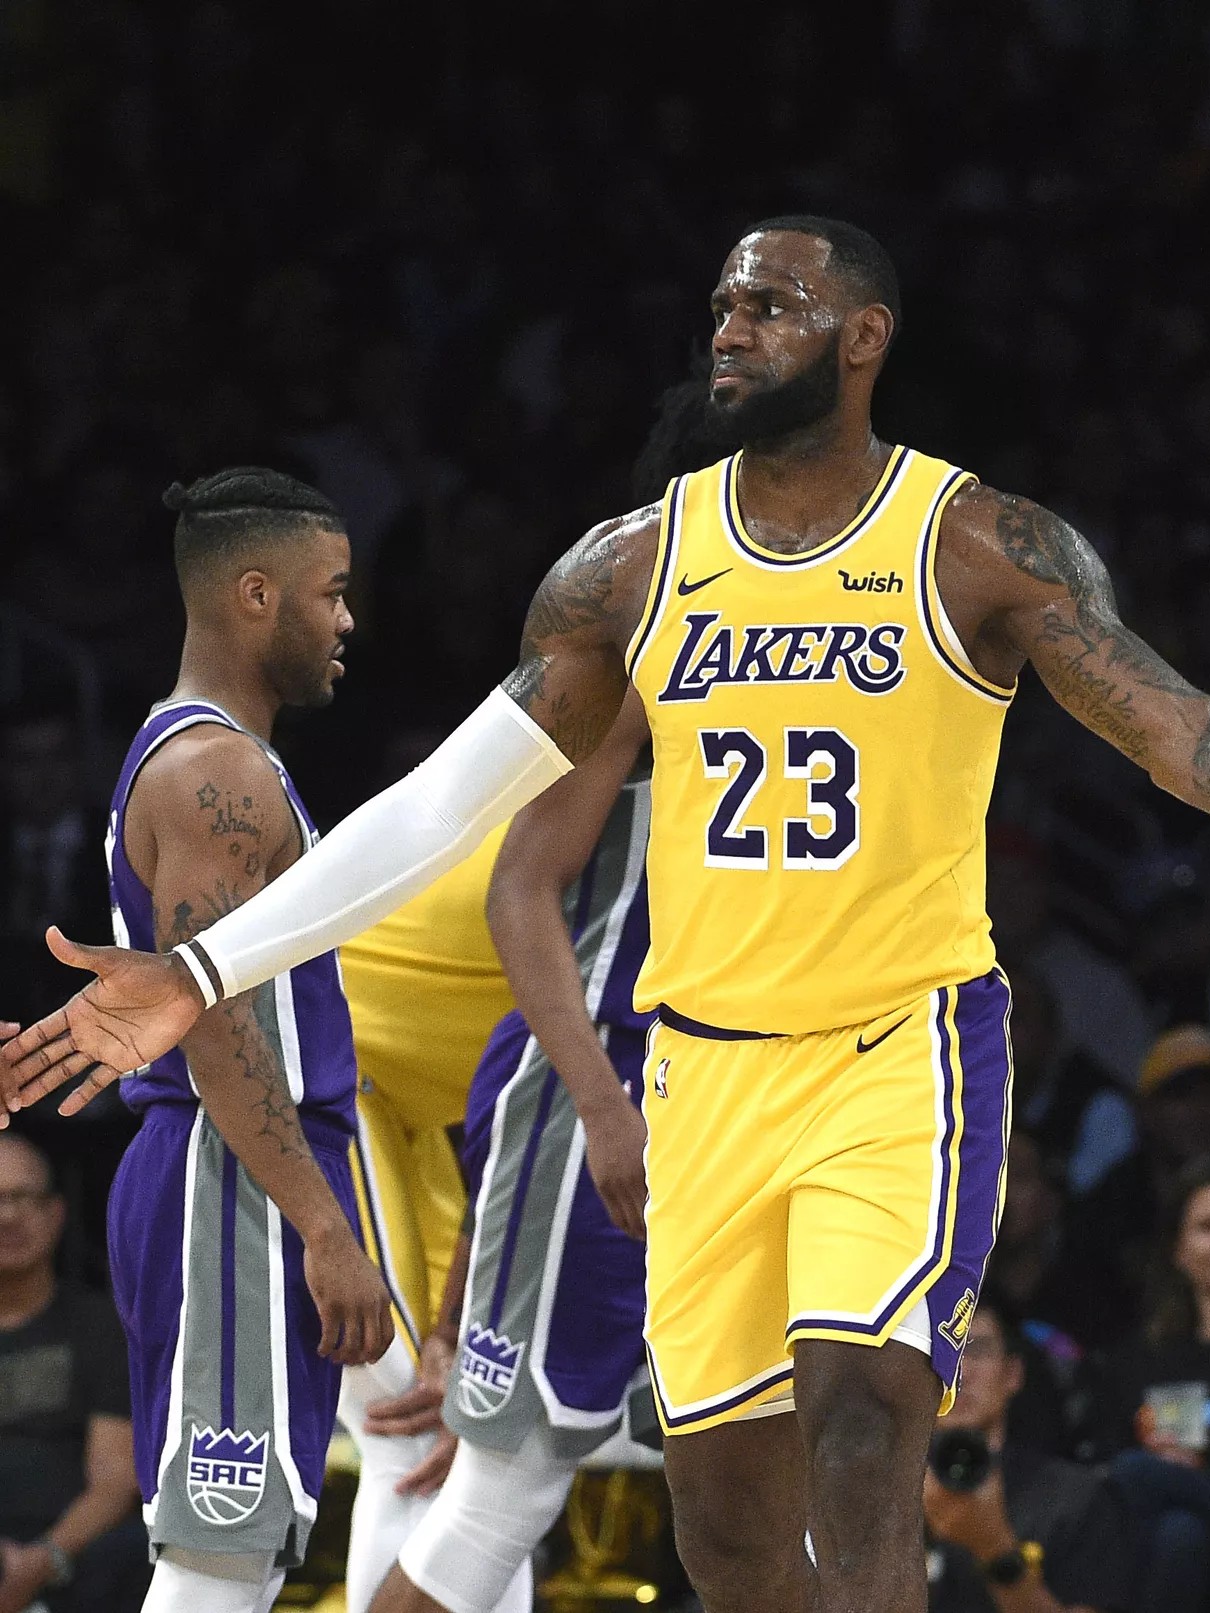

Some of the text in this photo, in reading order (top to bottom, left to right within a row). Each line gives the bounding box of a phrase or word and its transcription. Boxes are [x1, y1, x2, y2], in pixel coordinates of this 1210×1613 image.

[838, 569, 904, 593] wish
[656, 610, 907, 703] LAKERS
[697, 726, 860, 870] 23
[189, 1461, 263, 1487] SAC
